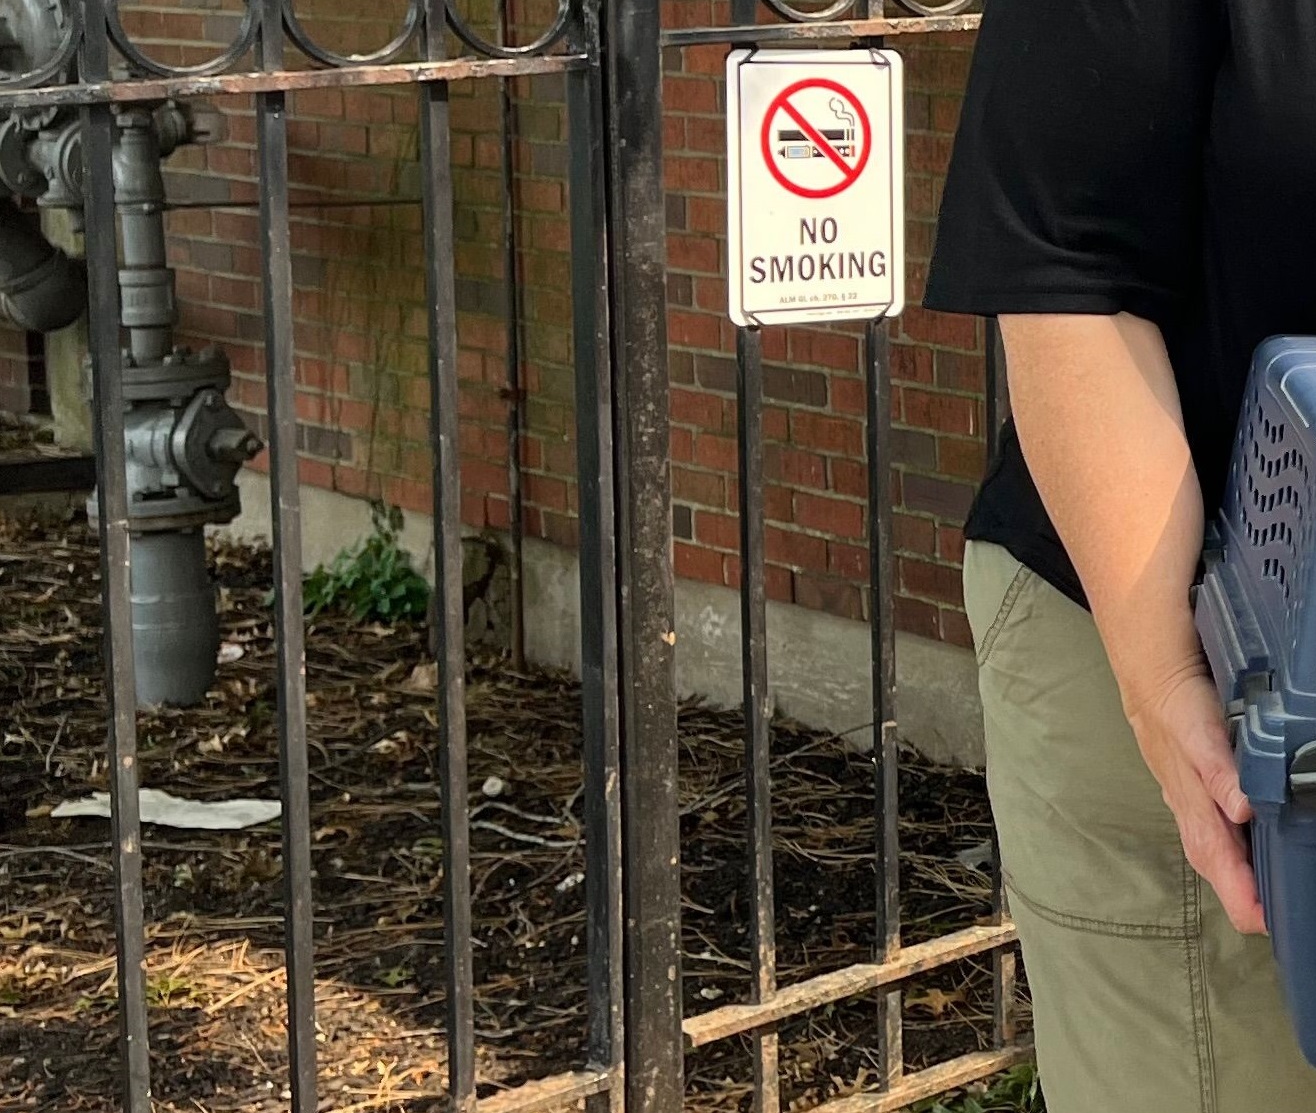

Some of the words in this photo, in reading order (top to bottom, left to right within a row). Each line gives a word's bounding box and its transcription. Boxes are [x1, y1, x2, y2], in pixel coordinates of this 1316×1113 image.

[800, 217, 838, 245] NO
[750, 250, 886, 284] SMOKING
[848, 292, 857, 300] 22
